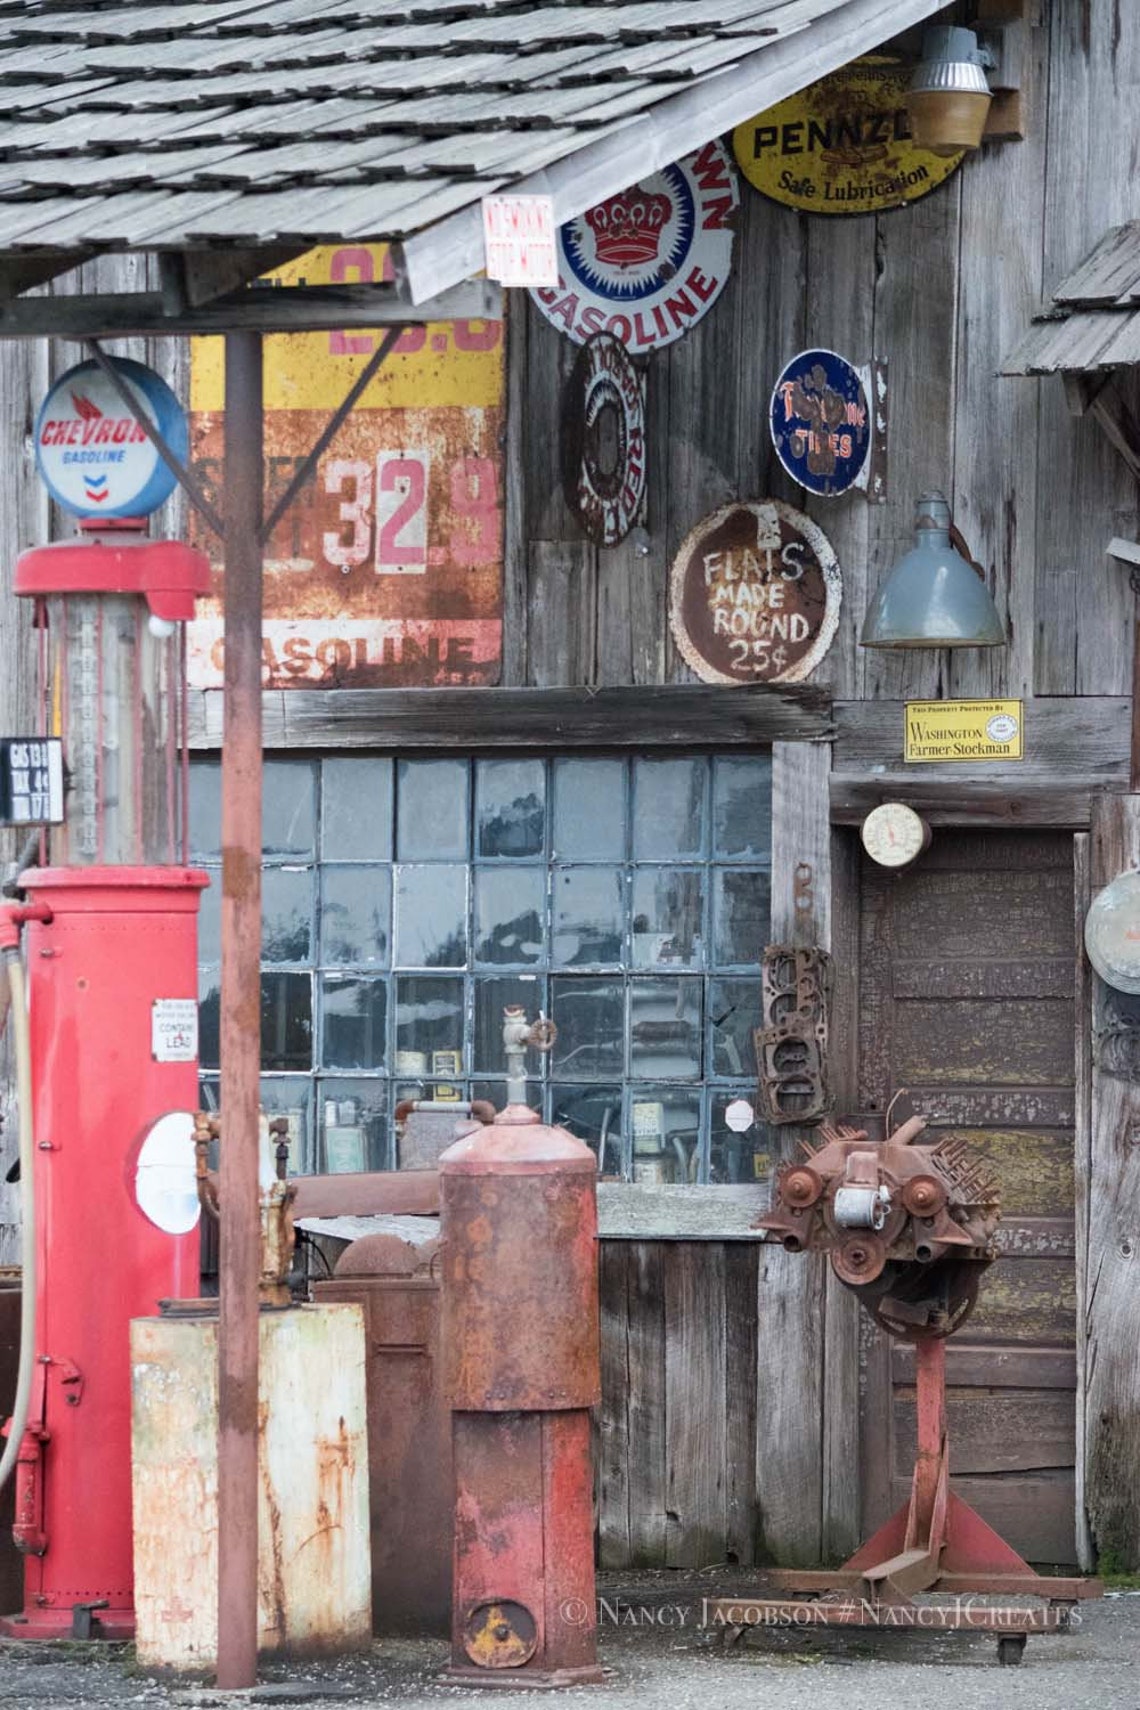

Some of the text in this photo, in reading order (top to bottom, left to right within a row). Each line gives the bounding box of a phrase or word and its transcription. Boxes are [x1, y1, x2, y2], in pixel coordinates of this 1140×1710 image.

[778, 171, 816, 198] Safe
[62, 449, 126, 464] GASOLINE
[715, 581, 785, 608] MADE
[714, 608, 809, 643] ROUND
[910, 721, 983, 742] WASHINGTON
